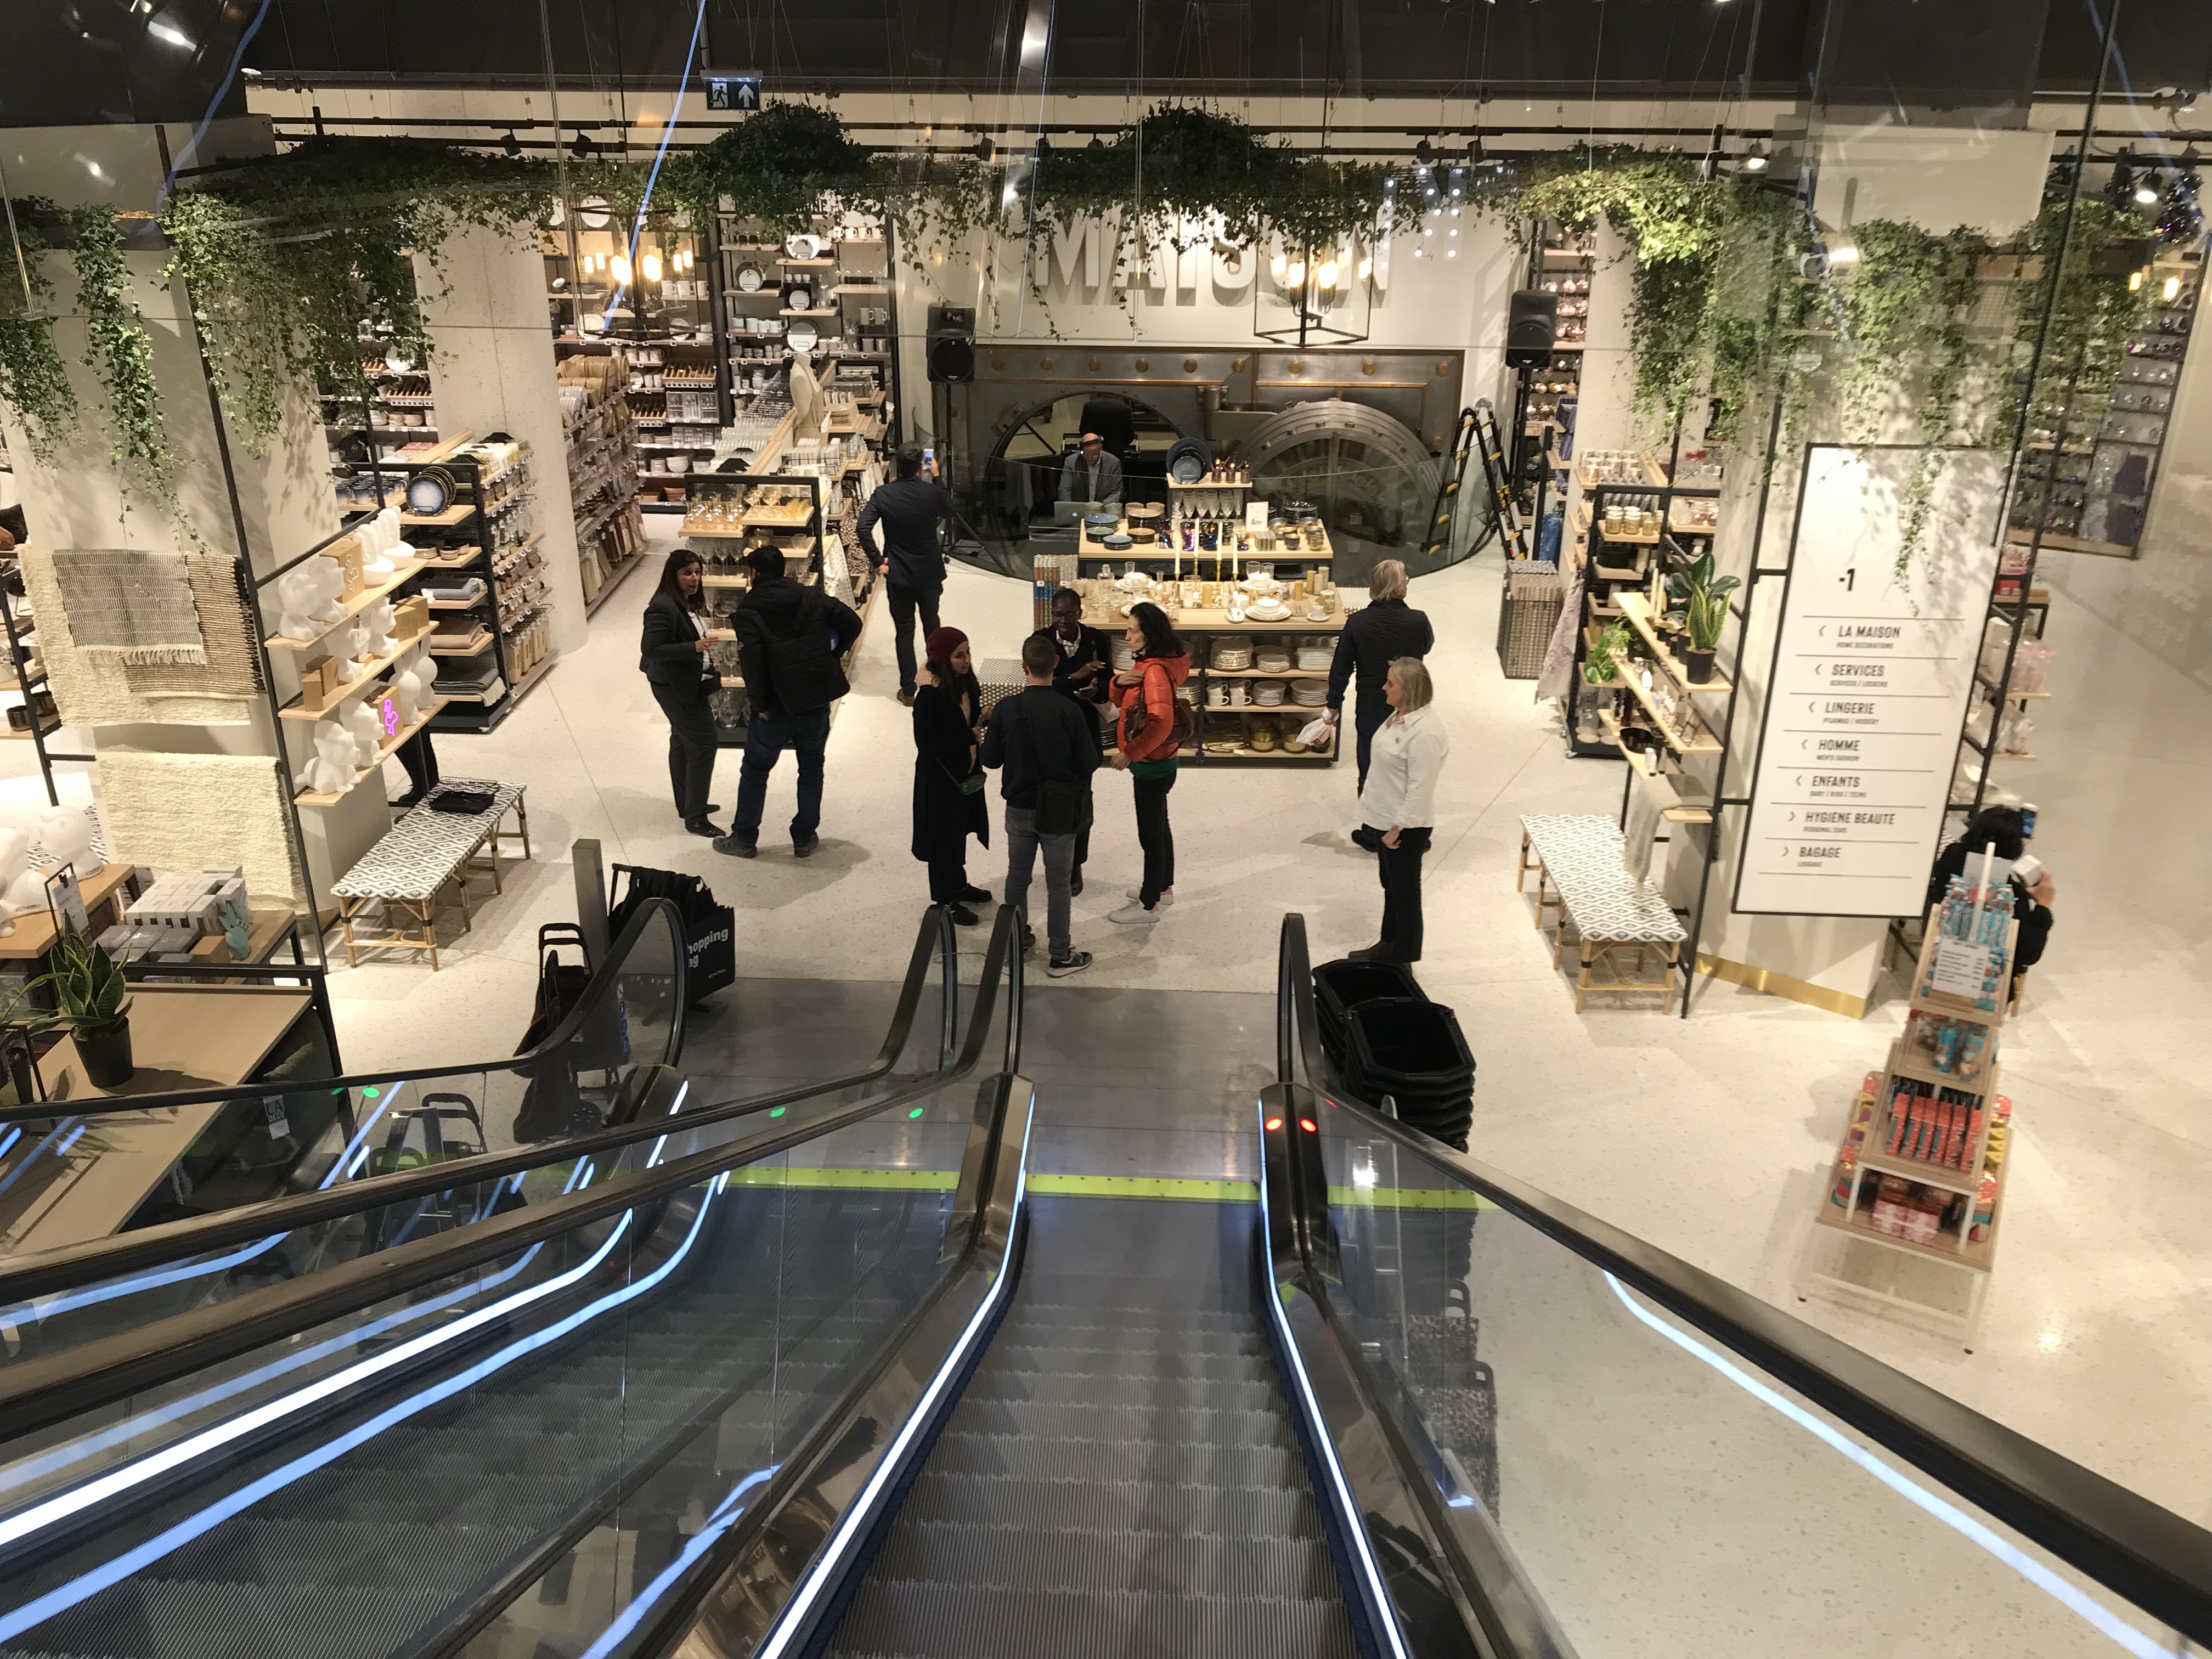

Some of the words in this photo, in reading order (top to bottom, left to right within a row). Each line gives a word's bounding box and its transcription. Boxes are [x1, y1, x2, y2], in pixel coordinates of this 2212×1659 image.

[1034, 206, 1392, 291] MAISON
[1838, 568, 1856, 592] -1
[1838, 625, 1852, 637] LA
[1855, 626, 1901, 638] MAISON
[1831, 664, 1886, 676] SERVICES
[1825, 702, 1876, 714] LINGERIE
[1818, 739, 1861, 751] HOMME
[1812, 775, 1861, 787] ENFANTS
[1804, 811, 1852, 823] HYGIENE
[1854, 812, 1896, 825] BEAUTE
[1798, 847, 1842, 858] BAGAGE
[687, 928, 729, 954] hopping
[689, 954, 699, 968] ag
[266, 1099, 283, 1115] LA
